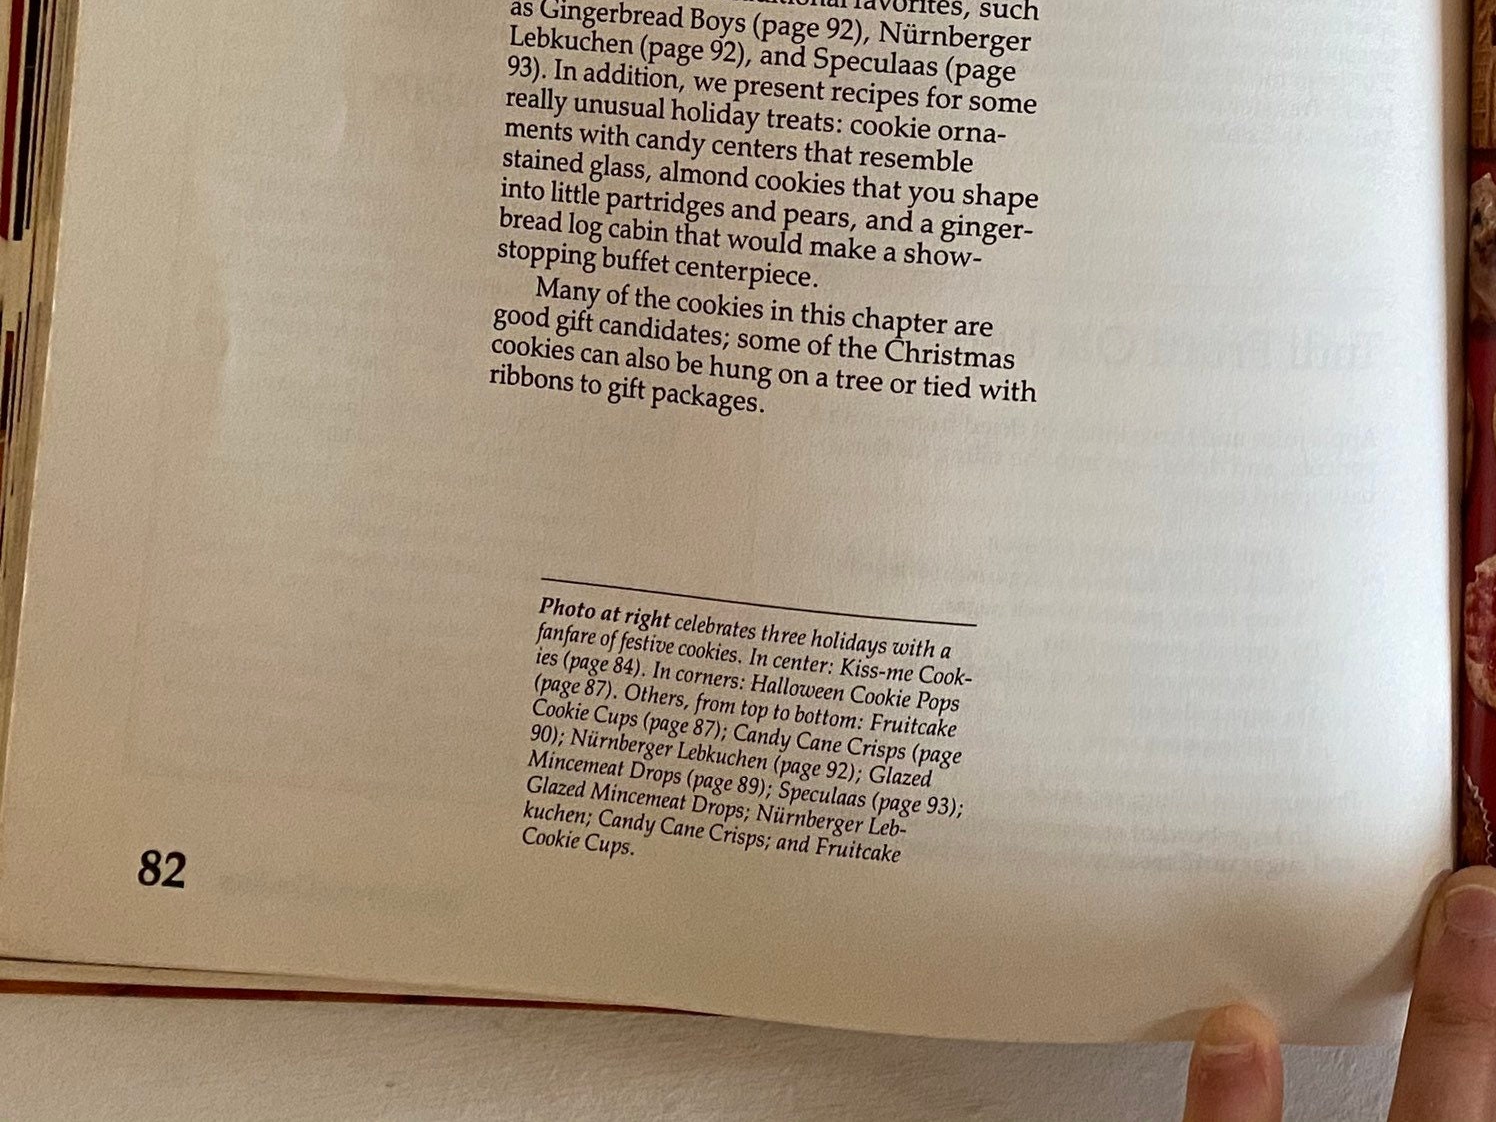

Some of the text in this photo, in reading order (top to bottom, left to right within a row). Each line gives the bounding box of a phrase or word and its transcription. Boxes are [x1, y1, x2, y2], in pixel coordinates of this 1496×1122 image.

[509, 0, 534, 18] as
[689, 7, 747, 39] Boys
[752, 11, 821, 45] (page
[825, 17, 871, 47] 92),
[878, 19, 1033, 59] Nürnberger
[507, 54, 1038, 115] 93). In addition, we present recipes for some
[503, 121, 974, 174] ments with candy centers that resemble
[500, 175, 1035, 246] into little partridges and pears, and a ginger-
[497, 239, 819, 291] stopping buffet centerpiece.
[492, 305, 1015, 371] good gift candidates; some of the Christmas
[535, 275, 994, 340] Many of the cookies in this chapter are
[489, 362, 765, 417] ribbons to gift packages.
[491, 335, 1037, 403] cookies can also be hung on a tree or tied with
[537, 596, 952, 660] Photo at right celebrates three holidays with a
[535, 645, 961, 717] ies (page 84). In corners: Halloween Cookie Pops
[529, 723, 933, 789] 90); Nürnberger Lebkuchen (page 92); Glazed
[532, 697, 963, 771] Cookie Cups (page 87); Candy Cane Crisps (page
[522, 799, 902, 863] kuchen; Candy Cane Crisps; and Fruitcake
[526, 775, 907, 837] Glazed Mincemeat Drops; Nürnberger Leb-
[137, 849, 187, 889] 82
[521, 825, 635, 860] Cookie Cups.
